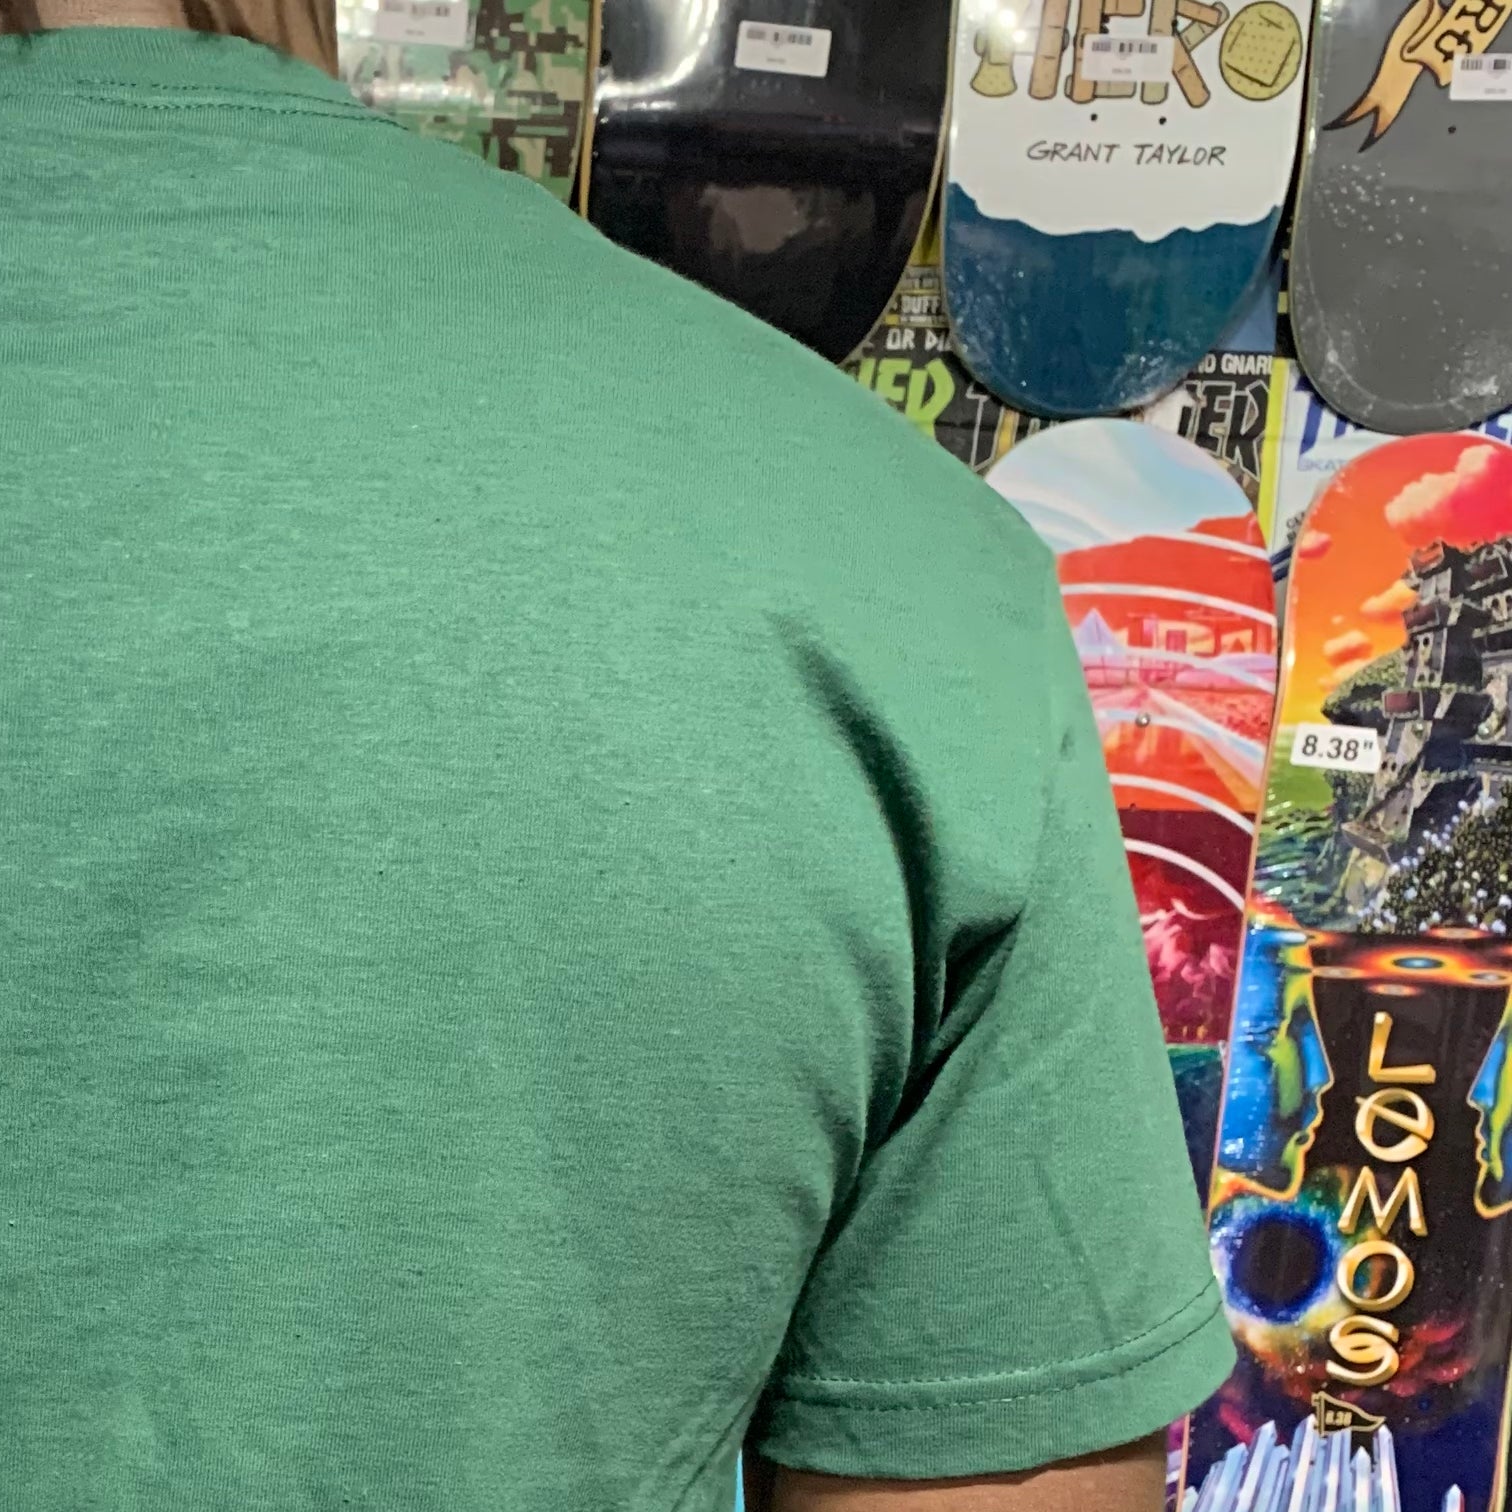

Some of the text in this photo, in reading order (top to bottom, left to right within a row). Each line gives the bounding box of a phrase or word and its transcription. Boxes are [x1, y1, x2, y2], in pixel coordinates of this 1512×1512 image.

[1026, 140, 1227, 167] GRANT TAYLOR
[1301, 735, 1374, 763] 8.38"
